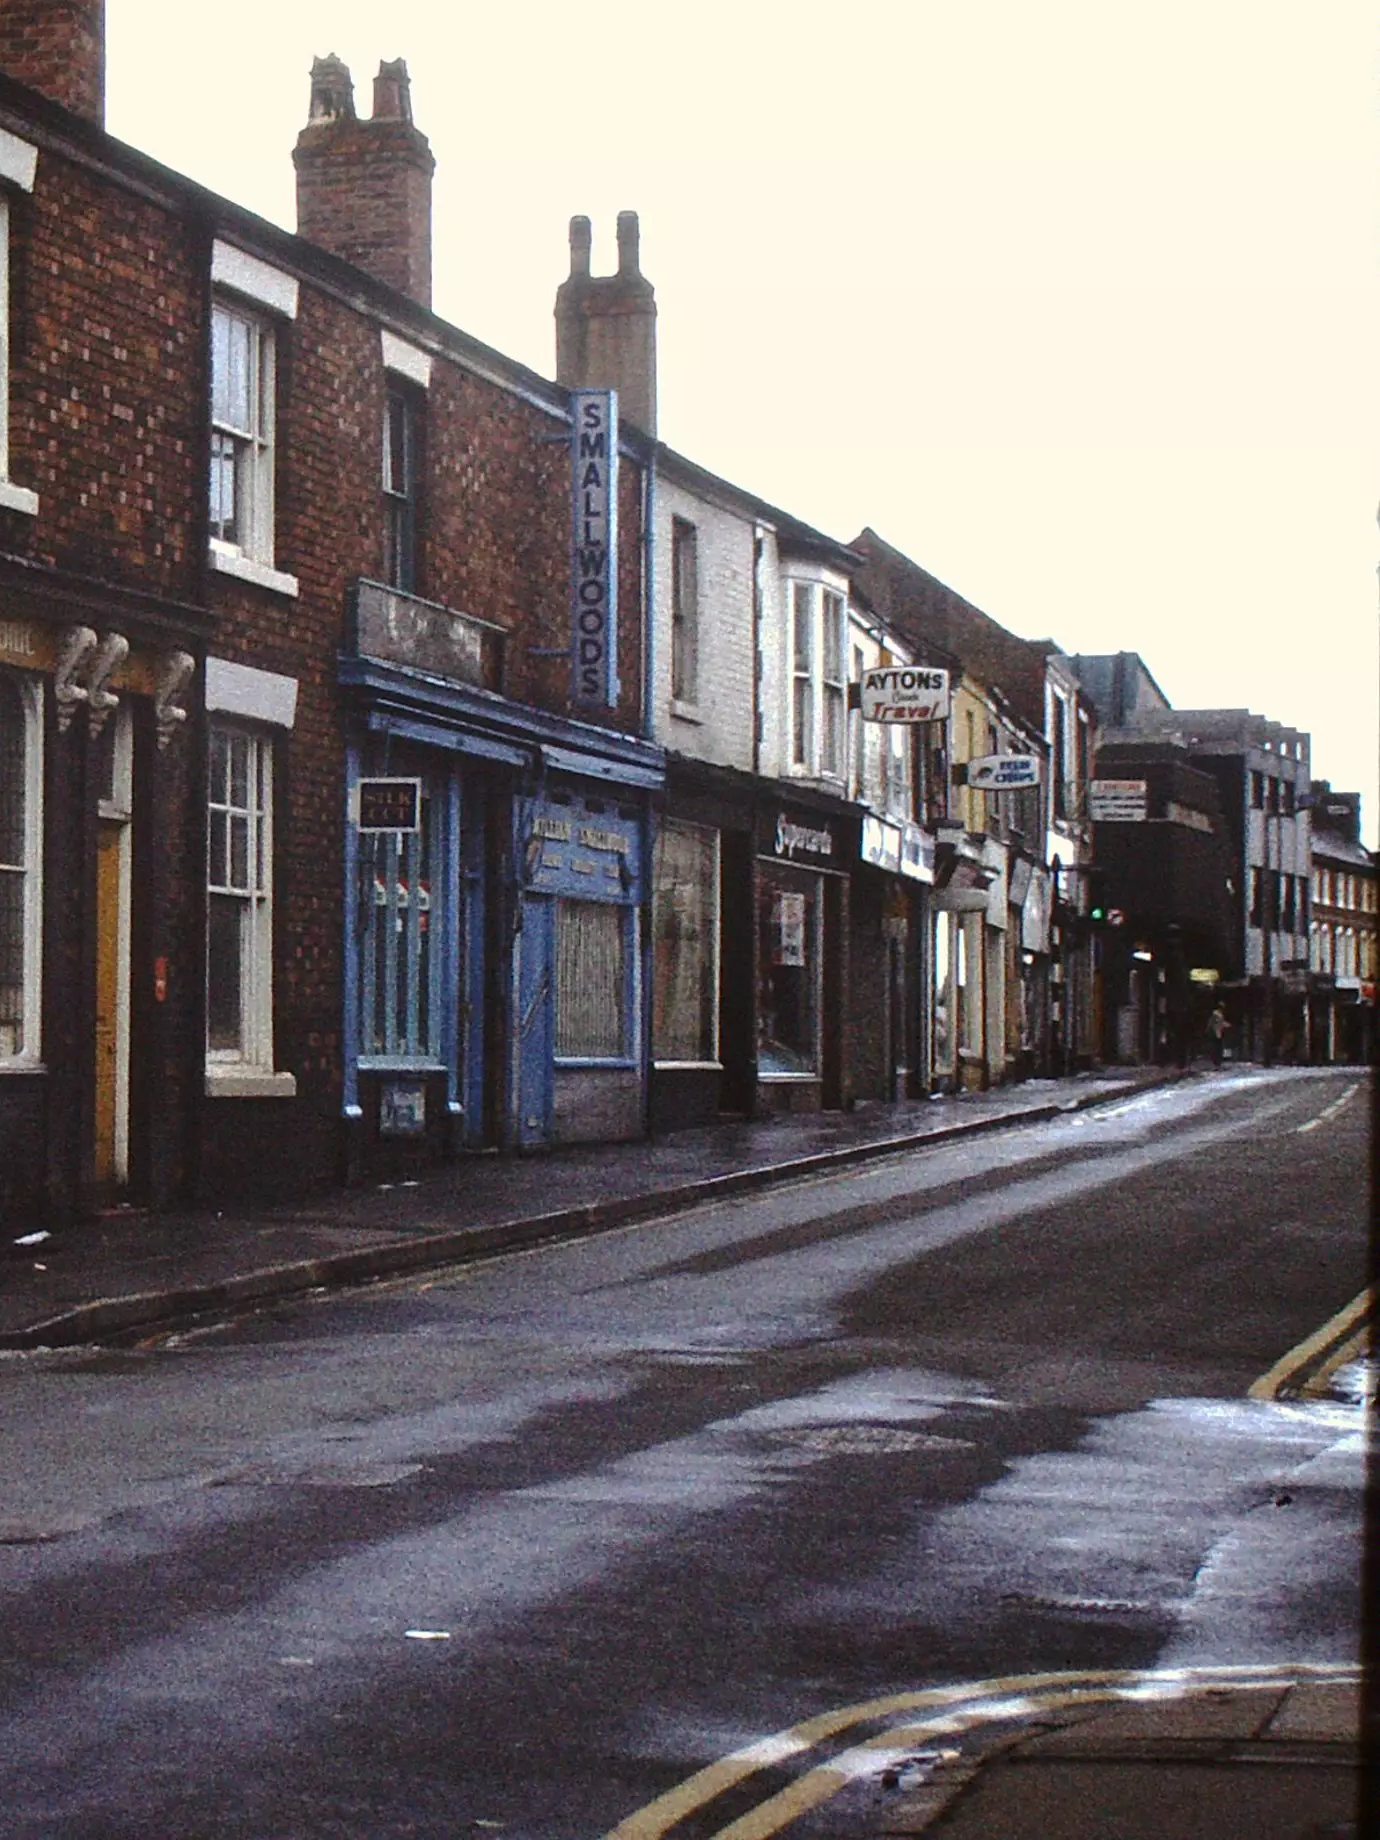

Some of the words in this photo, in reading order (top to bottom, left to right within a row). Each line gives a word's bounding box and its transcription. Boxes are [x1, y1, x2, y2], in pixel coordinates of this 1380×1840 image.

[578, 403, 606, 695] SMALLWOODS
[865, 671, 943, 690] AYTONS
[872, 701, 940, 719] Travel
